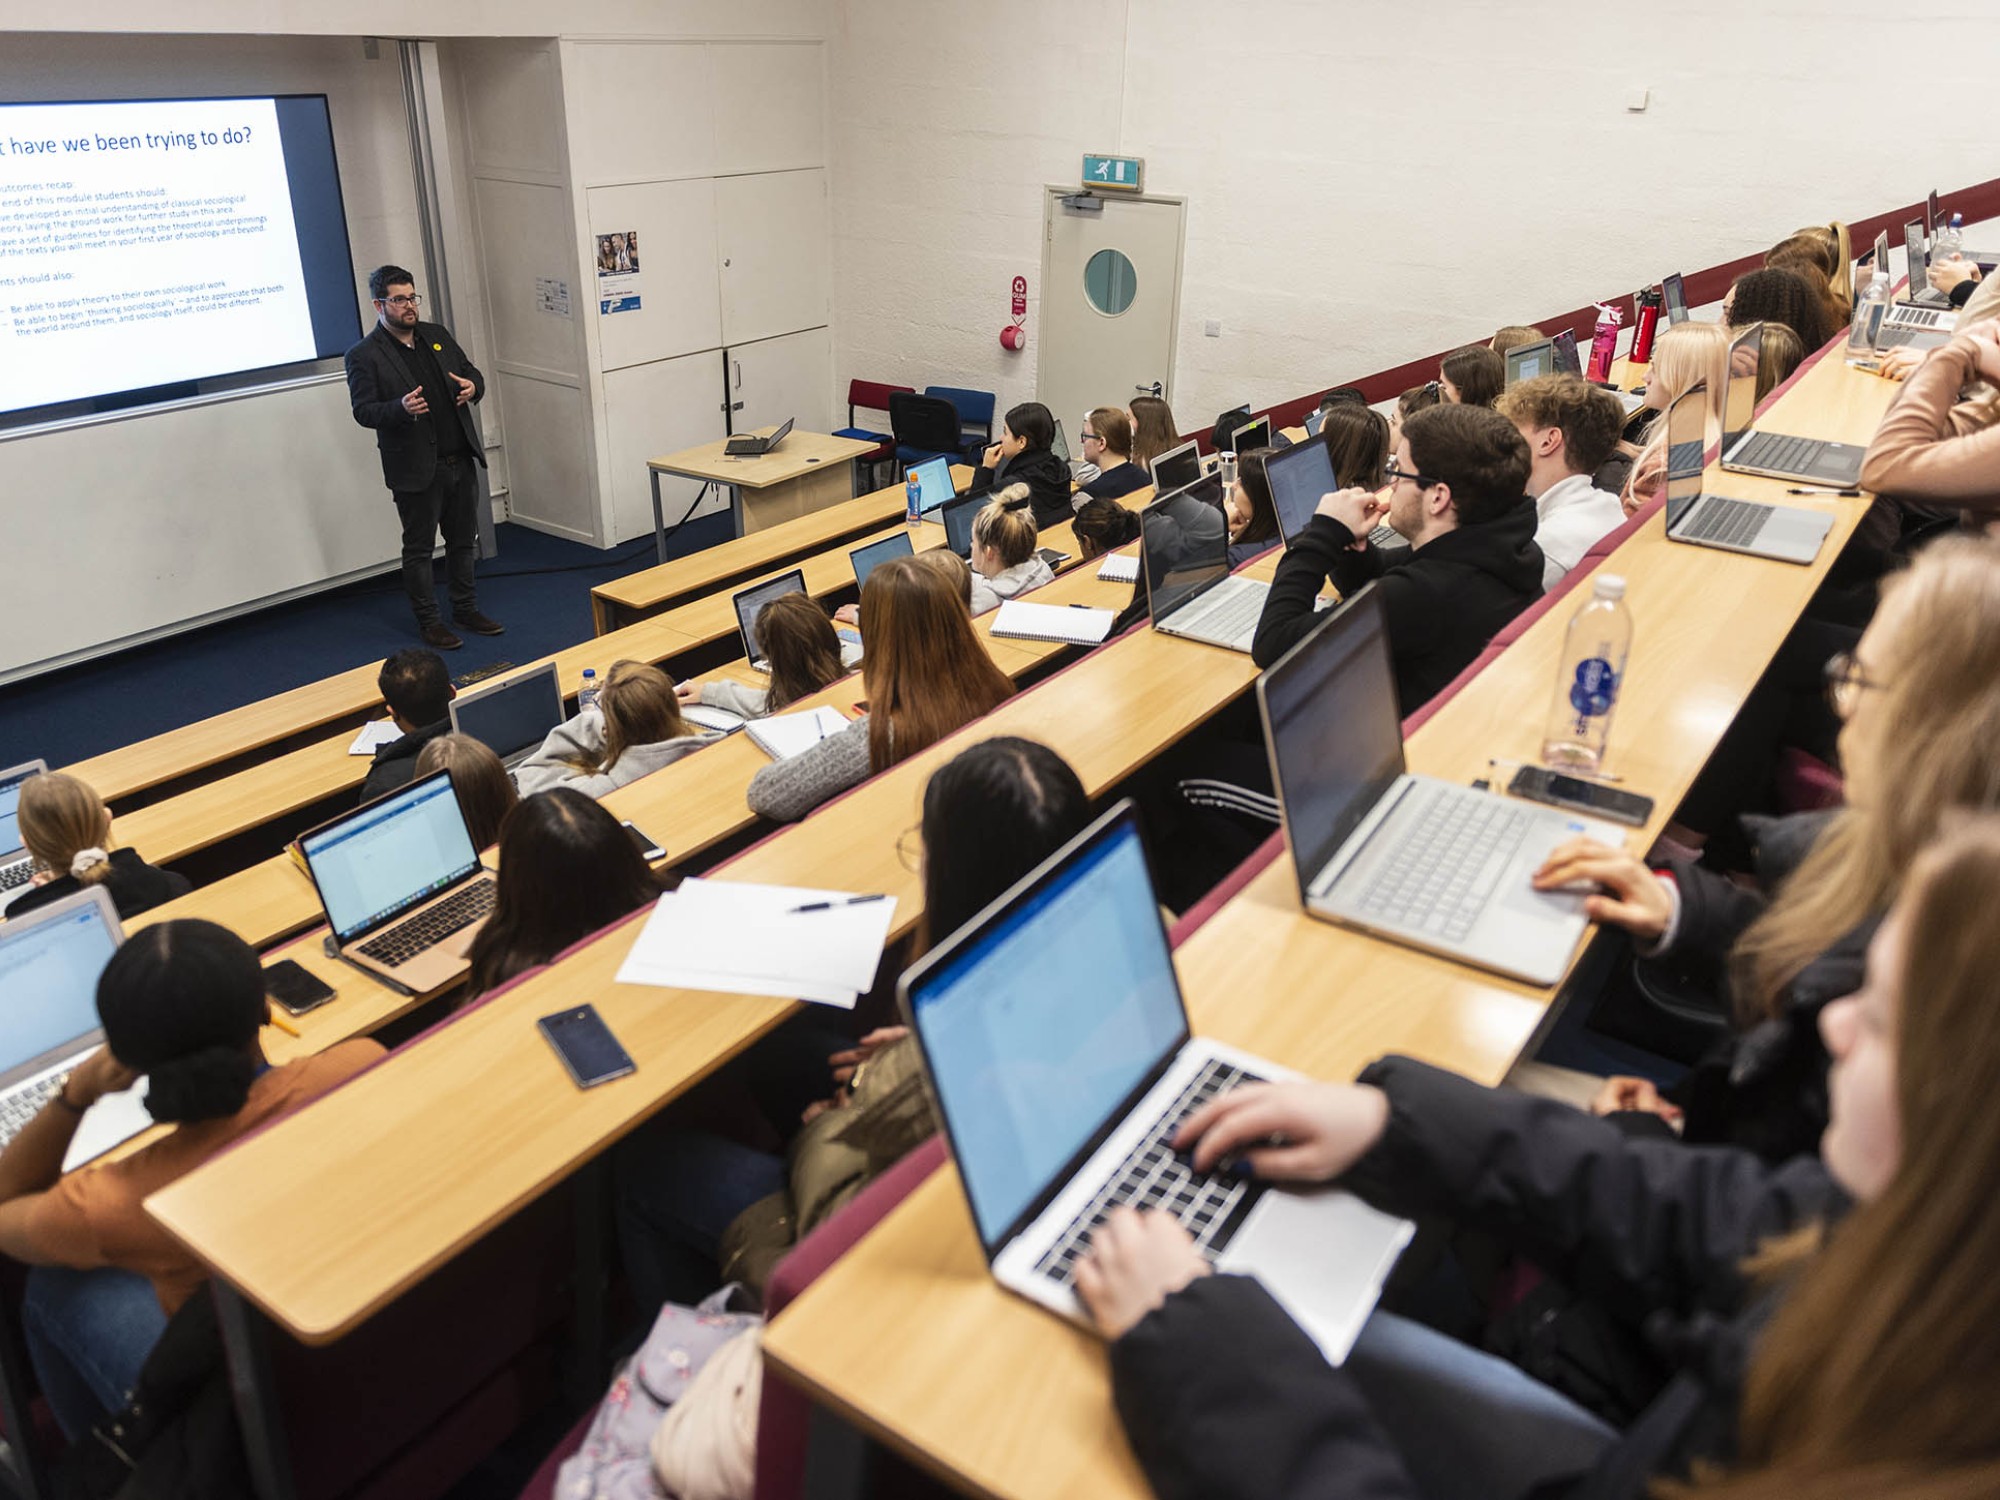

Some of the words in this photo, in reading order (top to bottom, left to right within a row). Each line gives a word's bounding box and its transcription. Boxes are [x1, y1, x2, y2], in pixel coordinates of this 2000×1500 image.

[10, 137, 56, 154] have
[62, 139, 90, 152] we
[95, 133, 141, 150] been
[146, 131, 197, 150] trying
[200, 131, 218, 145] to
[223, 126, 251, 144] do?
[2, 198, 21, 208] end
[24, 196, 33, 206] of
[36, 196, 54, 205] this
[56, 193, 92, 203] module
[95, 190, 134, 201] students
[13, 209, 60, 221] developed
[62, 209, 72, 217] an
[75, 206, 98, 216] initial
[100, 203, 159, 214] understanding
[161, 200, 168, 209] of
[171, 198, 202, 208] classical
[204, 195, 246, 206] sociological
[25, 222, 51, 232] laying
[54, 220, 68, 228] the
[70, 217, 100, 228] ground
[102, 215, 122, 224] work
[138, 212, 166, 221] further
[169, 210, 190, 218] study
[200, 207, 214, 215] this
[42, 234, 51, 242] of
[54, 230, 97, 243] guidelines
[99, 229, 110, 238] for
[113, 226, 156, 236] identifying
[172, 220, 214, 231] theoretical
[216, 216, 267, 226] underpinnings
[8, 248, 23, 256] the
[26, 246, 48, 254] texts
[50, 245, 66, 254] you
[68, 242, 82, 251] will
[85, 240, 106, 249] meet
[118, 238, 136, 246] your
[138, 236, 154, 244] first
[156, 234, 172, 242] year
[175, 232, 183, 240] of
[184, 229, 220, 240] sociology
[222, 227, 236, 236] and
[237, 224, 266, 234] beyond.
[18, 272, 50, 286] should
[10, 305, 22, 314] Be
[25, 302, 43, 312] able
[46, 302, 55, 310] to
[58, 298, 80, 308] apply
[82, 296, 110, 306] theory
[122, 291, 140, 300] their
[144, 289, 160, 298] own
[162, 282, 205, 296] sociological
[208, 280, 226, 289] work
[14, 318, 24, 327] Be
[28, 316, 46, 325] able
[48, 314, 58, 322] to
[60, 311, 84, 320] begin
[186, 296, 200, 304] and
[202, 294, 210, 302] to
[212, 290, 250, 302] appreciate
[251, 287, 266, 296] that
[267, 284, 284, 294] both
[16, 328, 31, 336] the
[34, 324, 58, 334] world
[61, 321, 90, 331] around
[119, 314, 134, 322] and
[136, 310, 172, 320] sociology
[196, 302, 216, 312] could
[218, 301, 227, 310] be
